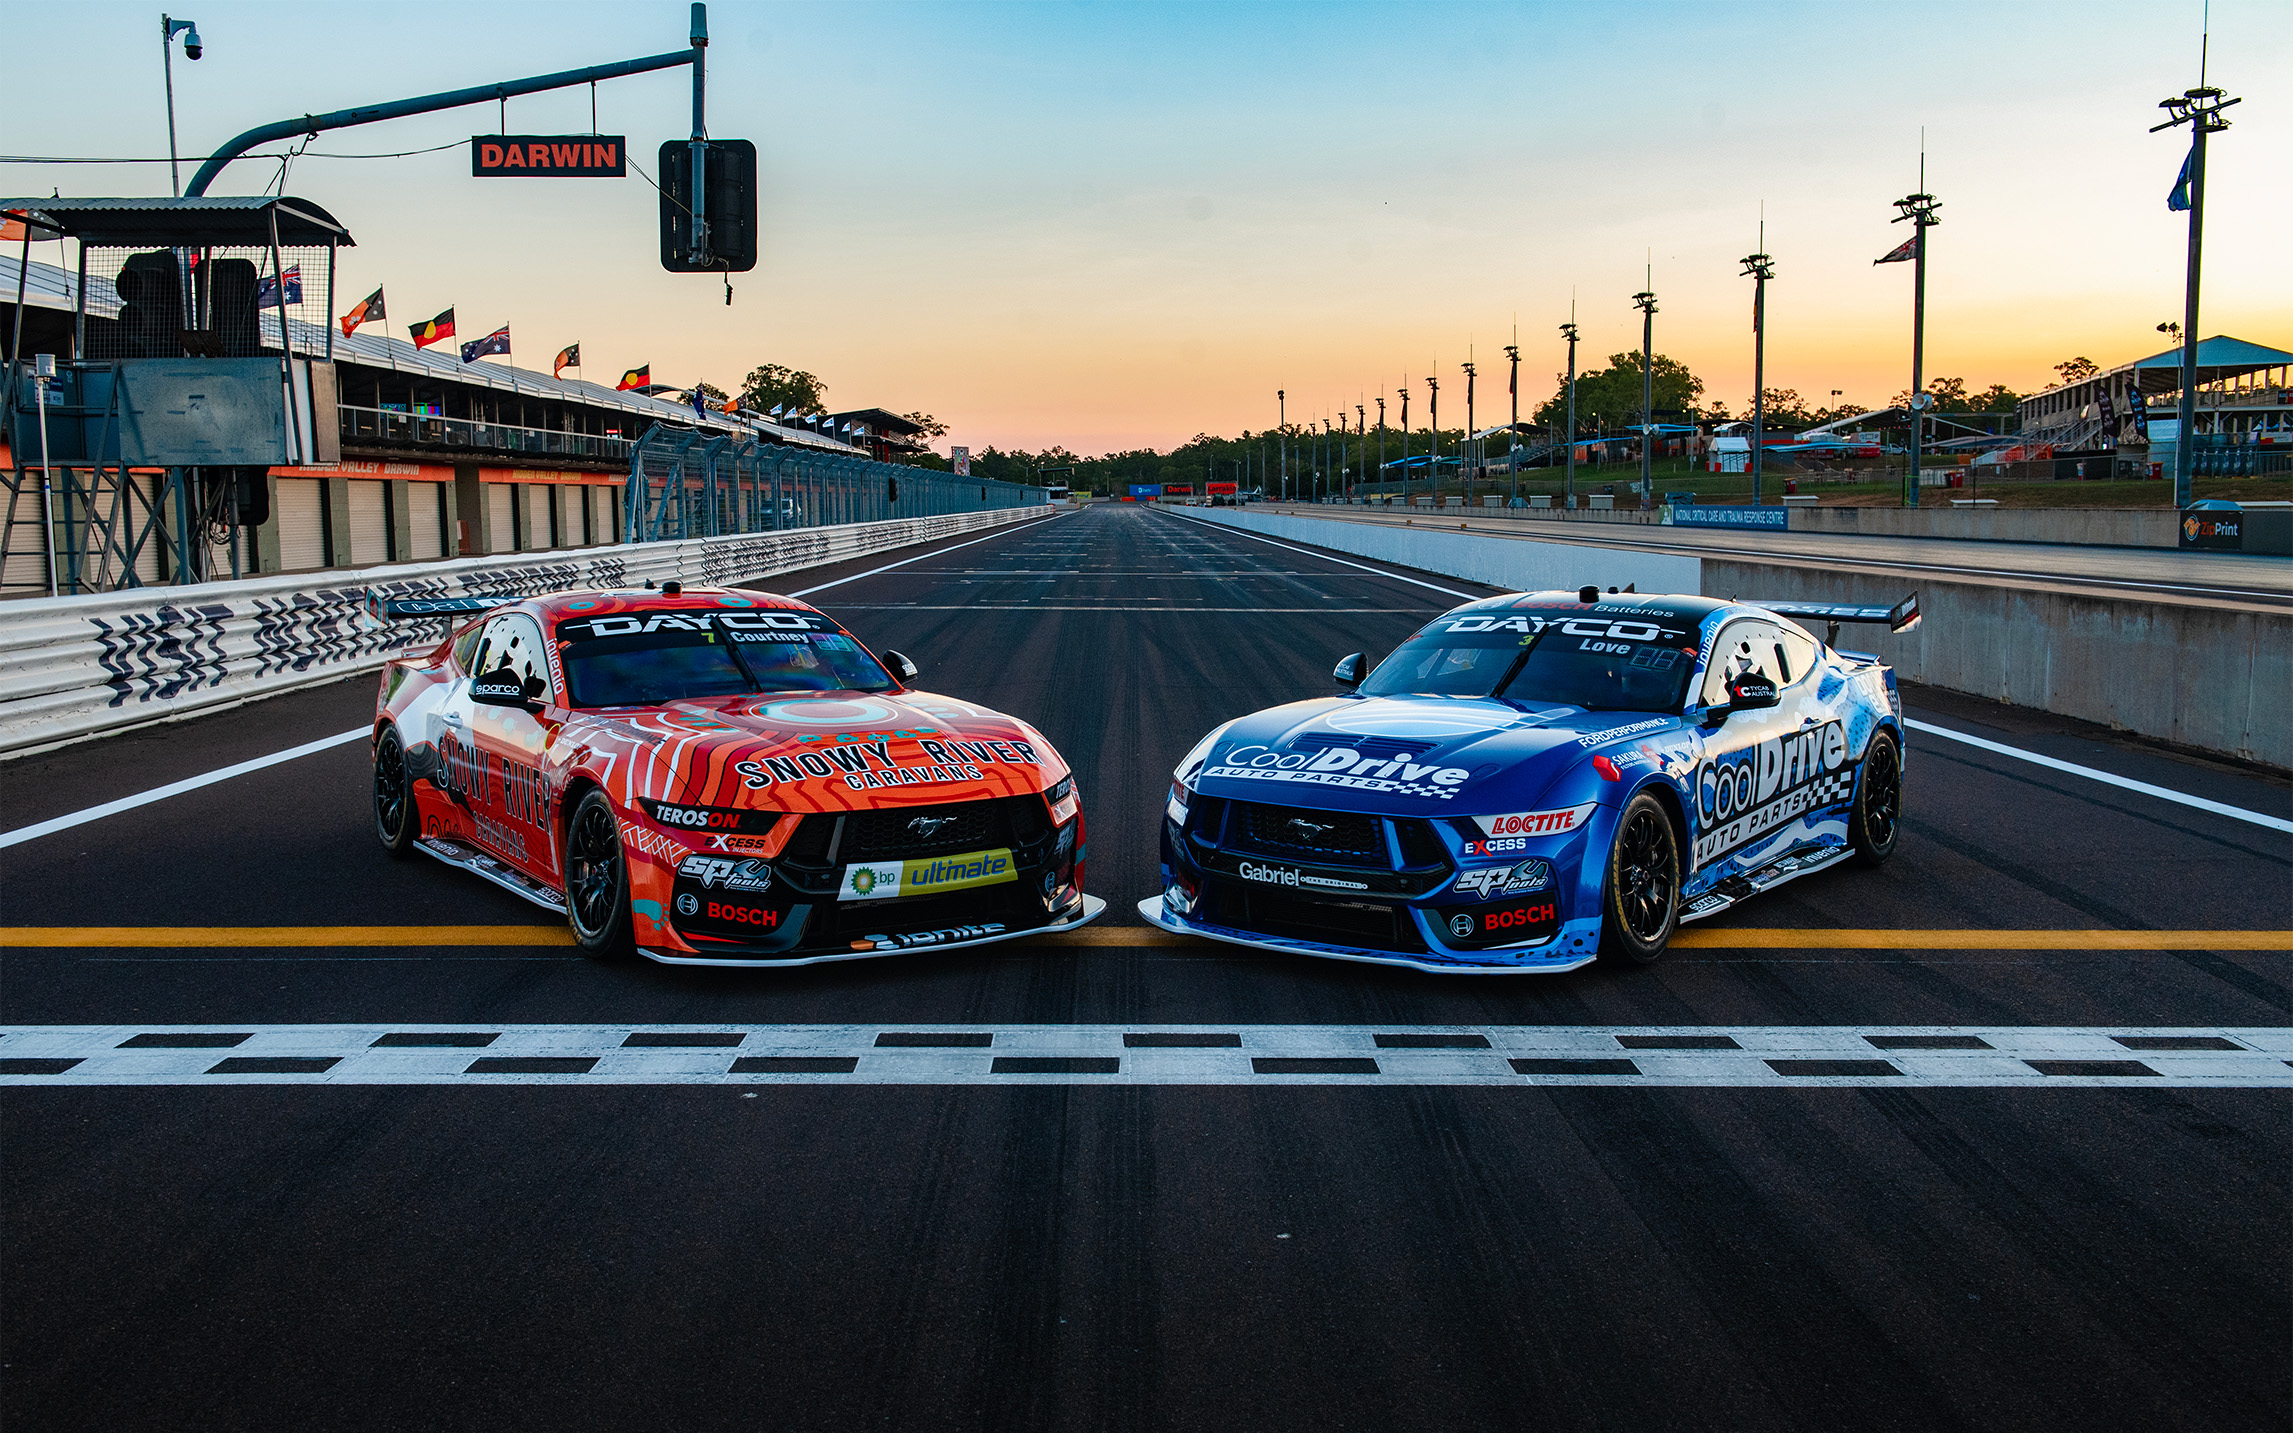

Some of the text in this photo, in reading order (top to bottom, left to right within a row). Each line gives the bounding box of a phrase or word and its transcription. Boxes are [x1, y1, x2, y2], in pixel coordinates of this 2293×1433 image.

[481, 143, 616, 168] DARWIN
[341, 461, 379, 474] VALLEY
[384, 463, 419, 476] DARWIN
[1708, 510, 1719, 522] CARE
[1719, 510, 1727, 522] AND
[1744, 511, 1765, 524] RESPONSE
[1766, 511, 1784, 525] CENTRE
[2201, 521, 2238, 538] ZipPrint
[1511, 601, 1675, 618] BOSCH Batteries
[586, 612, 812, 637] DAYCO
[1453, 615, 1661, 641] DAYCO
[701, 631, 808, 644] 7 Courtney
[1518, 635, 1631, 655] 3 Love
[1697, 621, 1720, 668] invenio
[547, 637, 564, 696] invenio
[475, 682, 520, 695] sparco
[735, 739, 1046, 790] SNOWY RIVER
[1224, 745, 1470, 786] CoolDrive
[1612, 750, 1646, 766] SAKURA
[437, 736, 550, 836] SNOWY RIVER
[846, 764, 984, 791] CARAVANS
[1211, 766, 1381, 789] AUTO PARTS
[1697, 722, 1846, 830] CoolDrive
[656, 805, 740, 828] TEROSON
[1492, 810, 1574, 834] LOCTITE
[1697, 796, 1803, 861] AUTO PARTS
[472, 811, 529, 864] CARAVANS
[1802, 846, 1841, 864] invenio
[681, 857, 735, 886] SP
[879, 854, 1006, 886] bp ultimate
[1240, 862, 1299, 887] Gabriel
[1456, 867, 1513, 897] SP
[708, 902, 777, 926] BOSCH
[1485, 904, 1554, 930] BOSCH
